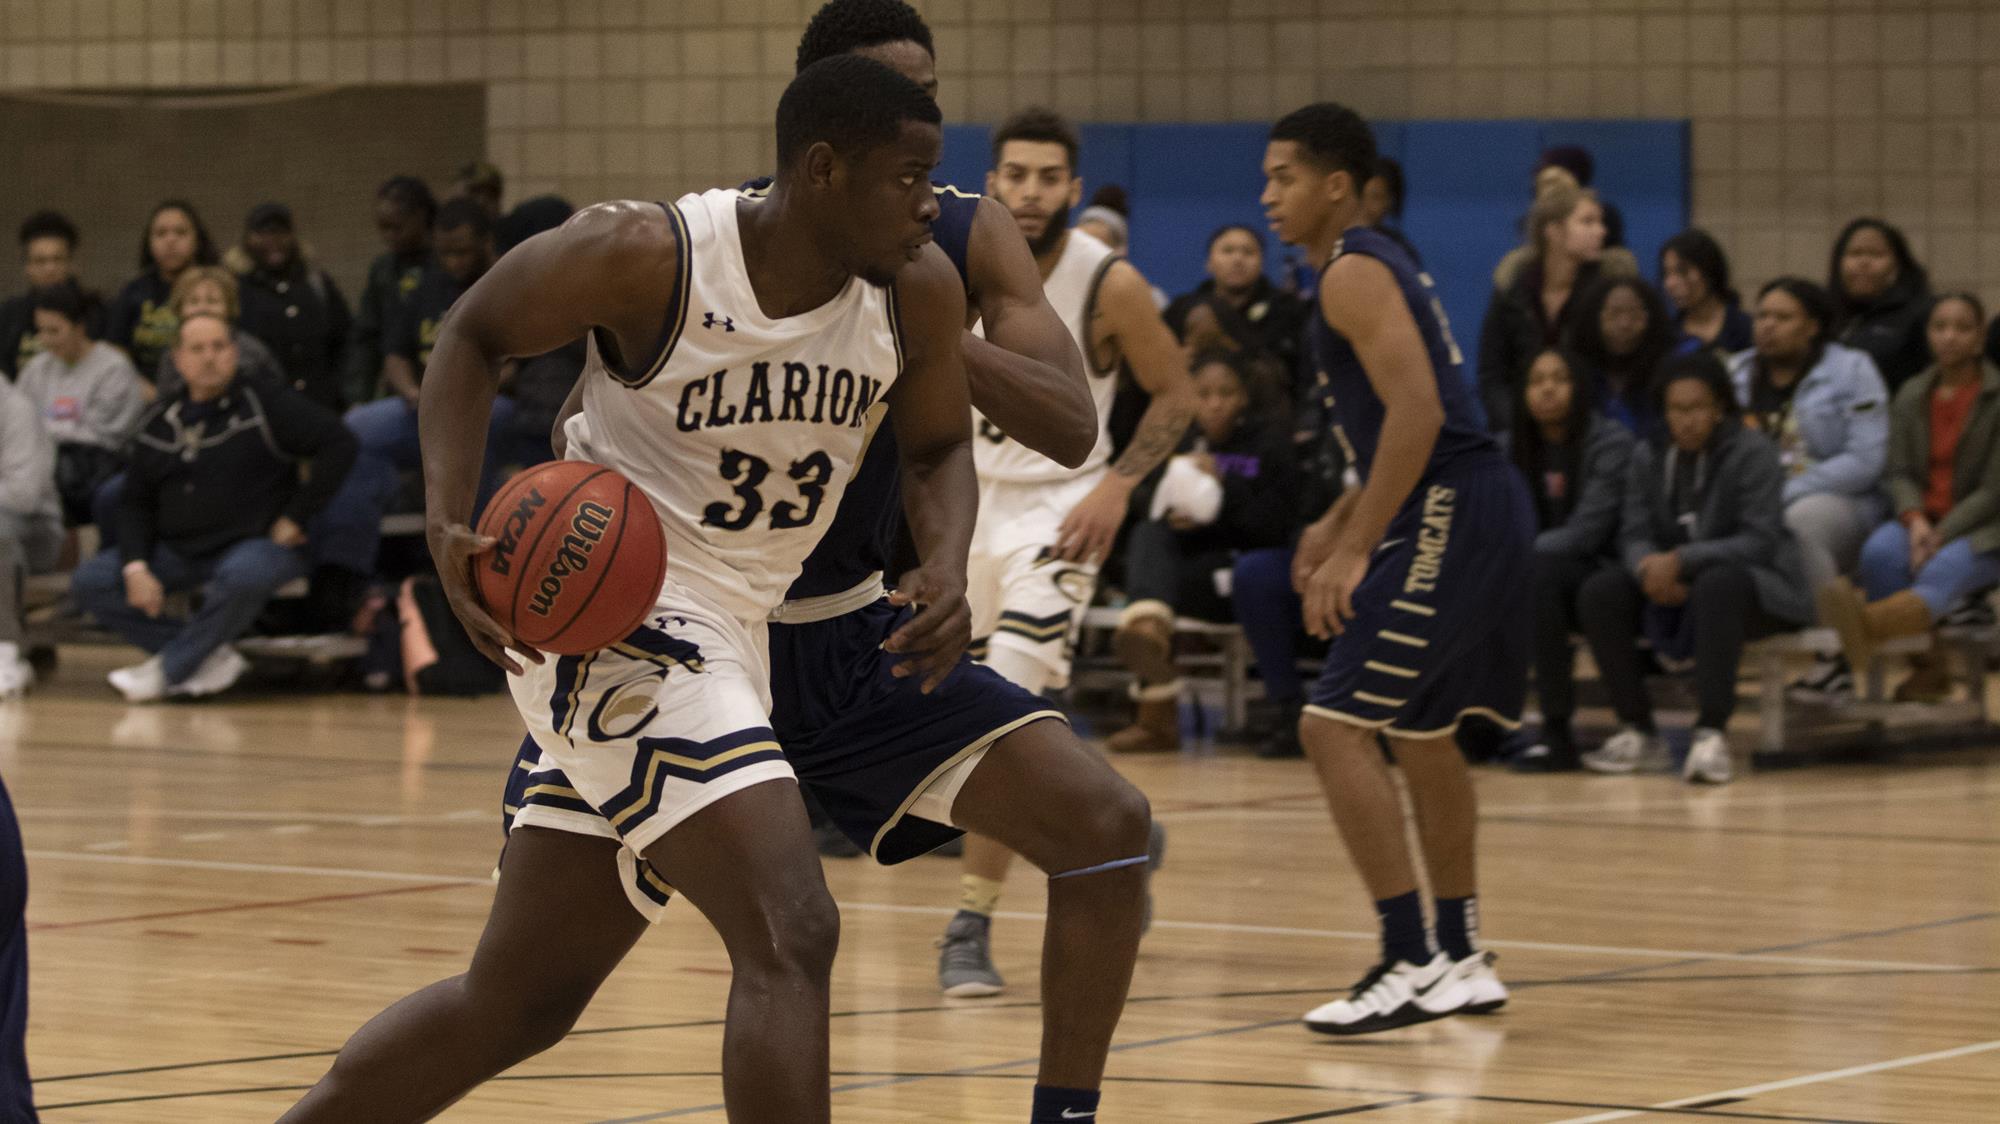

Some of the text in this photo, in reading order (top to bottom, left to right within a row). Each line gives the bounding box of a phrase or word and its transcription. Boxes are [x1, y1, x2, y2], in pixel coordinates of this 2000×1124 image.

[676, 361, 882, 432] CLARION
[489, 487, 547, 577] NCAA
[700, 448, 834, 531] 33
[527, 500, 615, 618] Wilson
[1403, 484, 1457, 593] TOMCATS
